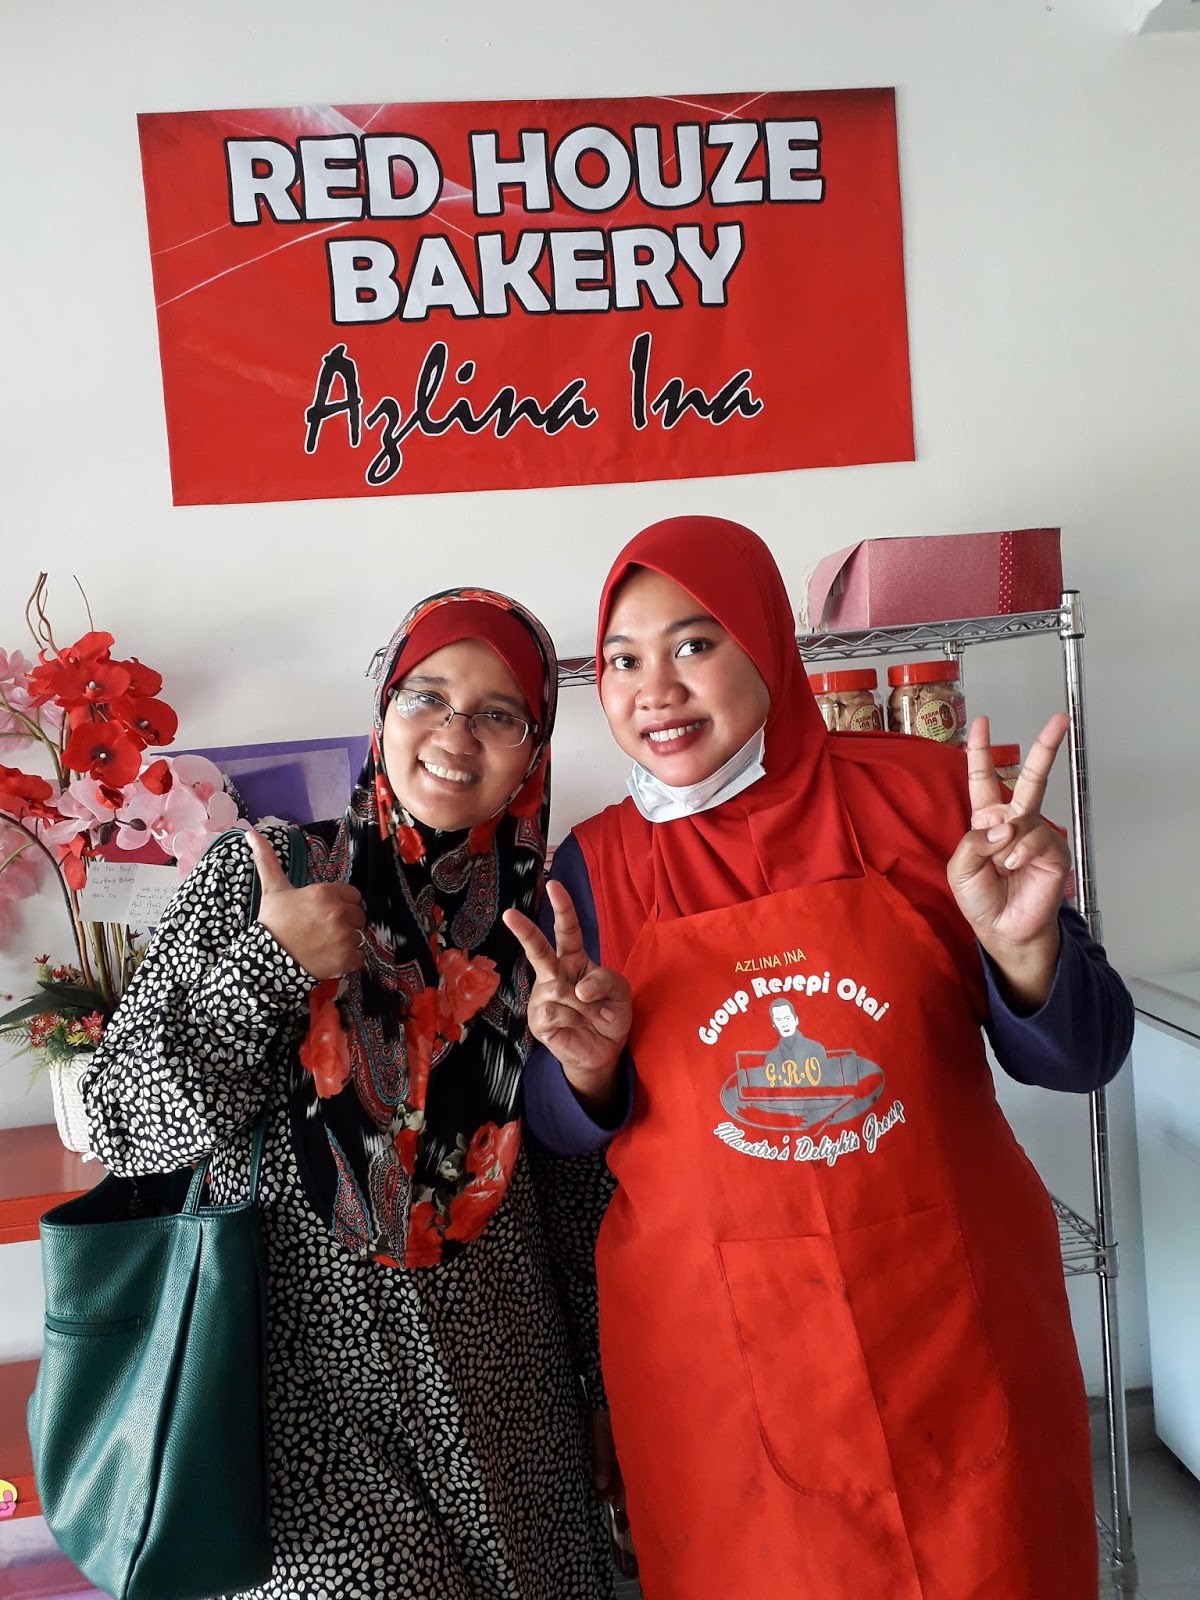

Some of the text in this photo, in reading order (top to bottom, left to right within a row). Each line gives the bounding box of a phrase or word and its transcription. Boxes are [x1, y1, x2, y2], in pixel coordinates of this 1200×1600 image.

[224, 118, 825, 226] RED HOUZE
[327, 223, 743, 325] BAKERY
[304, 331, 763, 487] Azlina Ina
[734, 948, 807, 973] AZLINA INA
[698, 971, 891, 1045] Group Resepi Otai
[713, 1100, 905, 1167] Maestro's Delights Group
